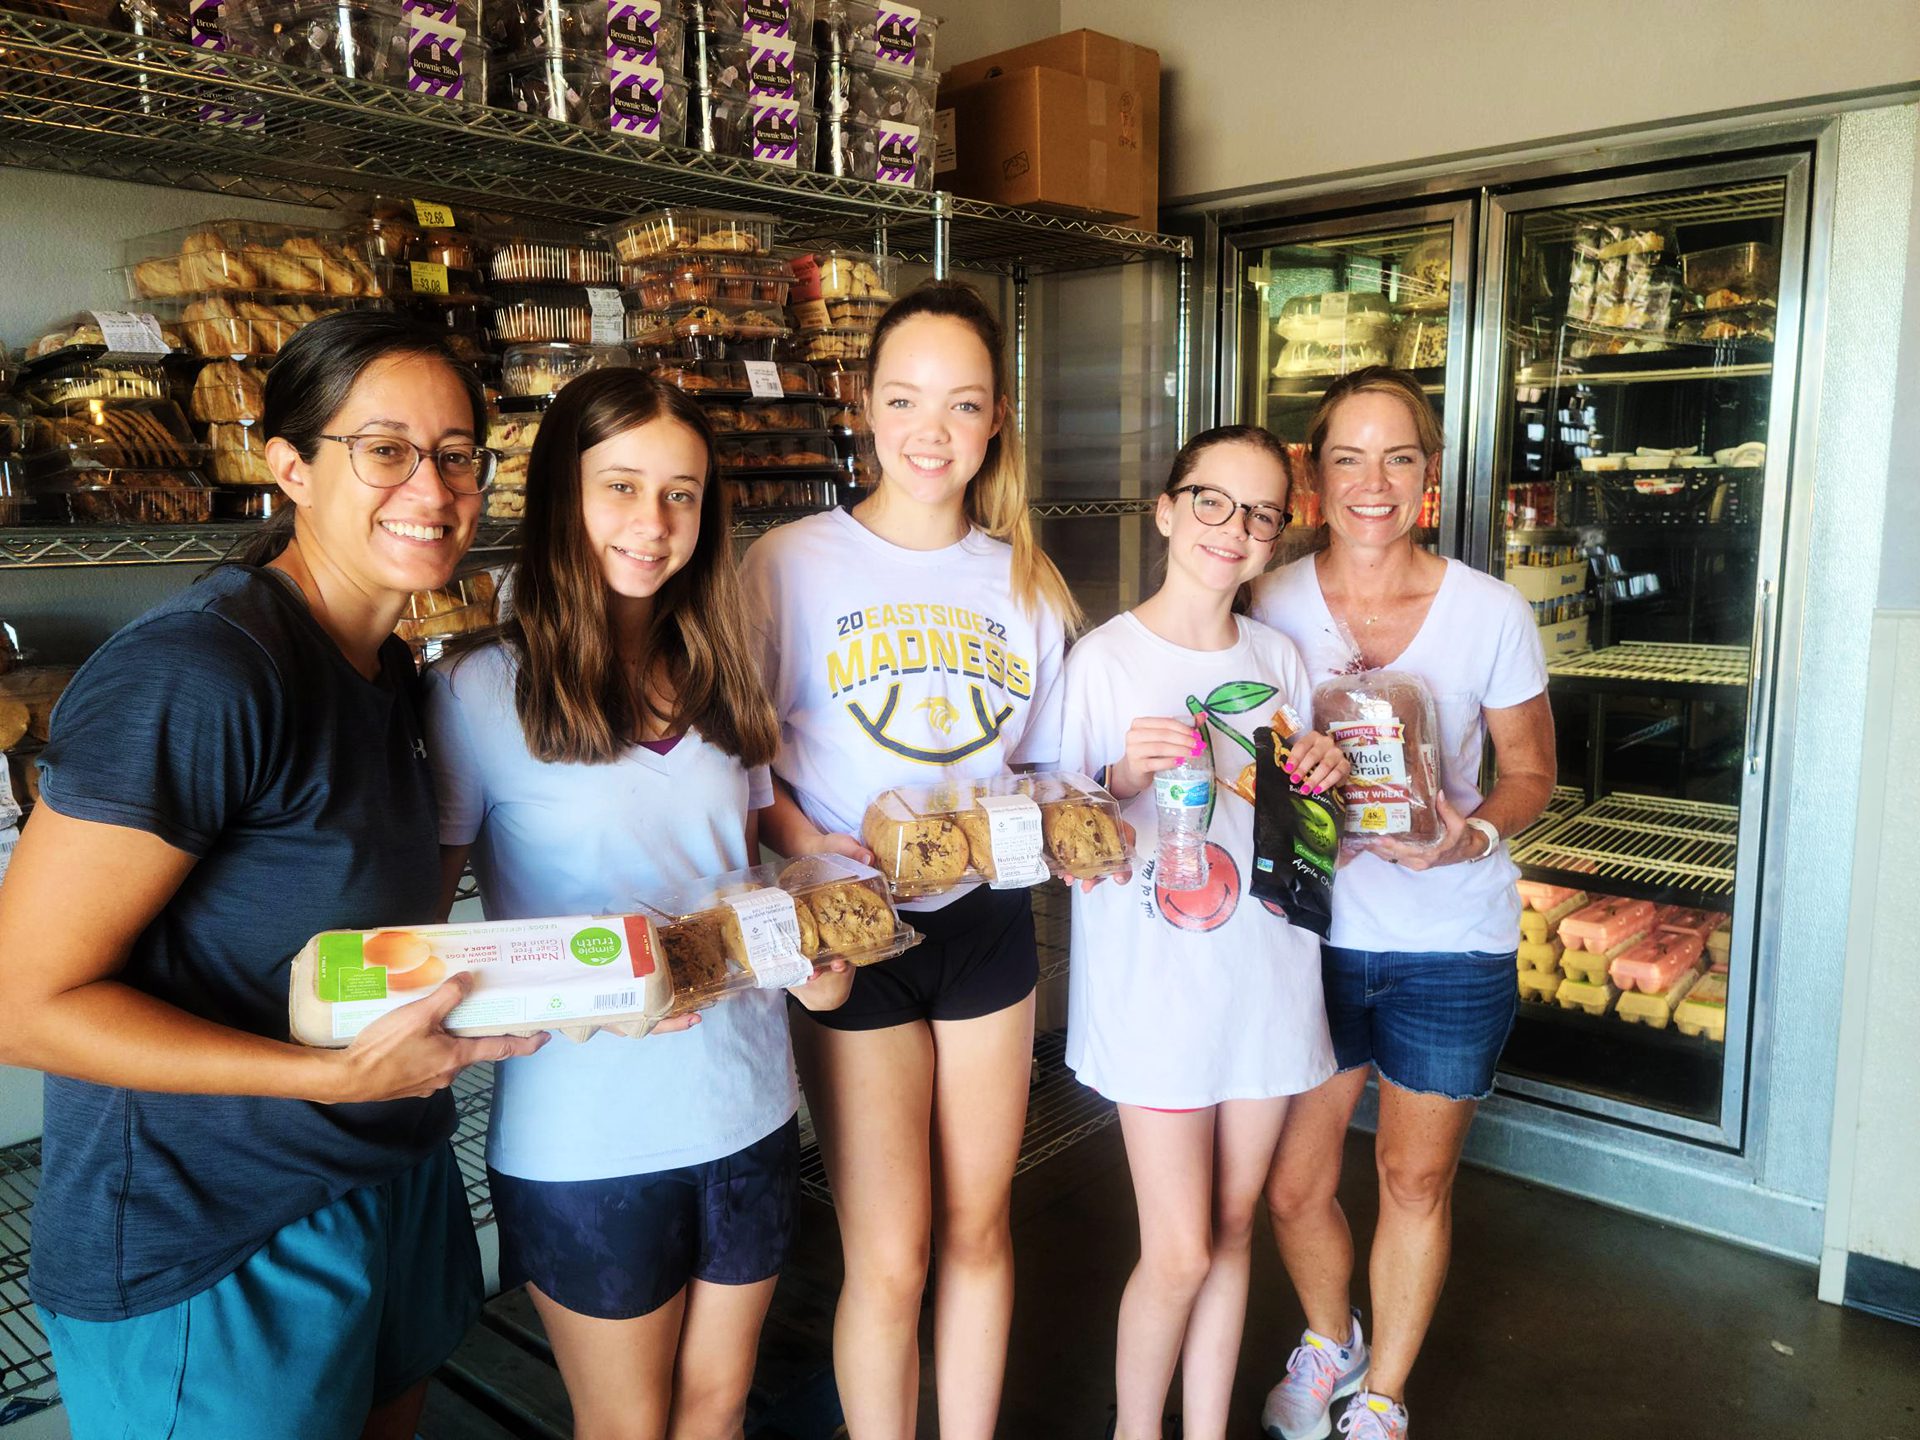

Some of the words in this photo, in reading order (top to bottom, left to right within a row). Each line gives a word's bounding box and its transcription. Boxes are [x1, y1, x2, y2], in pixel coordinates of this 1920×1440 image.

[747, 5, 771, 17] Brownie
[196, 18, 218, 29] Brow
[610, 29, 638, 43] Brownie
[413, 58, 442, 73] Brownie
[442, 65, 459, 77] Bites
[753, 72, 776, 82] Brownie
[614, 98, 641, 110] Brownie
[757, 130, 780, 139] Brownie
[424, 210, 445, 225] $2.68
[837, 611, 864, 637] 20
[864, 603, 987, 638] EASTSIDE
[985, 617, 1008, 643] 22
[826, 628, 1032, 702] MADNESS
[1343, 750, 1392, 764] Whole
[1349, 764, 1391, 777] Grain
[1345, 791, 1370, 799] ONEY
[1371, 790, 1404, 798] WHEAT
[1292, 858, 1318, 878] Apple
[576, 937, 614, 948] truth
[578, 945, 615, 955] simple
[511, 952, 559, 964] Natural
